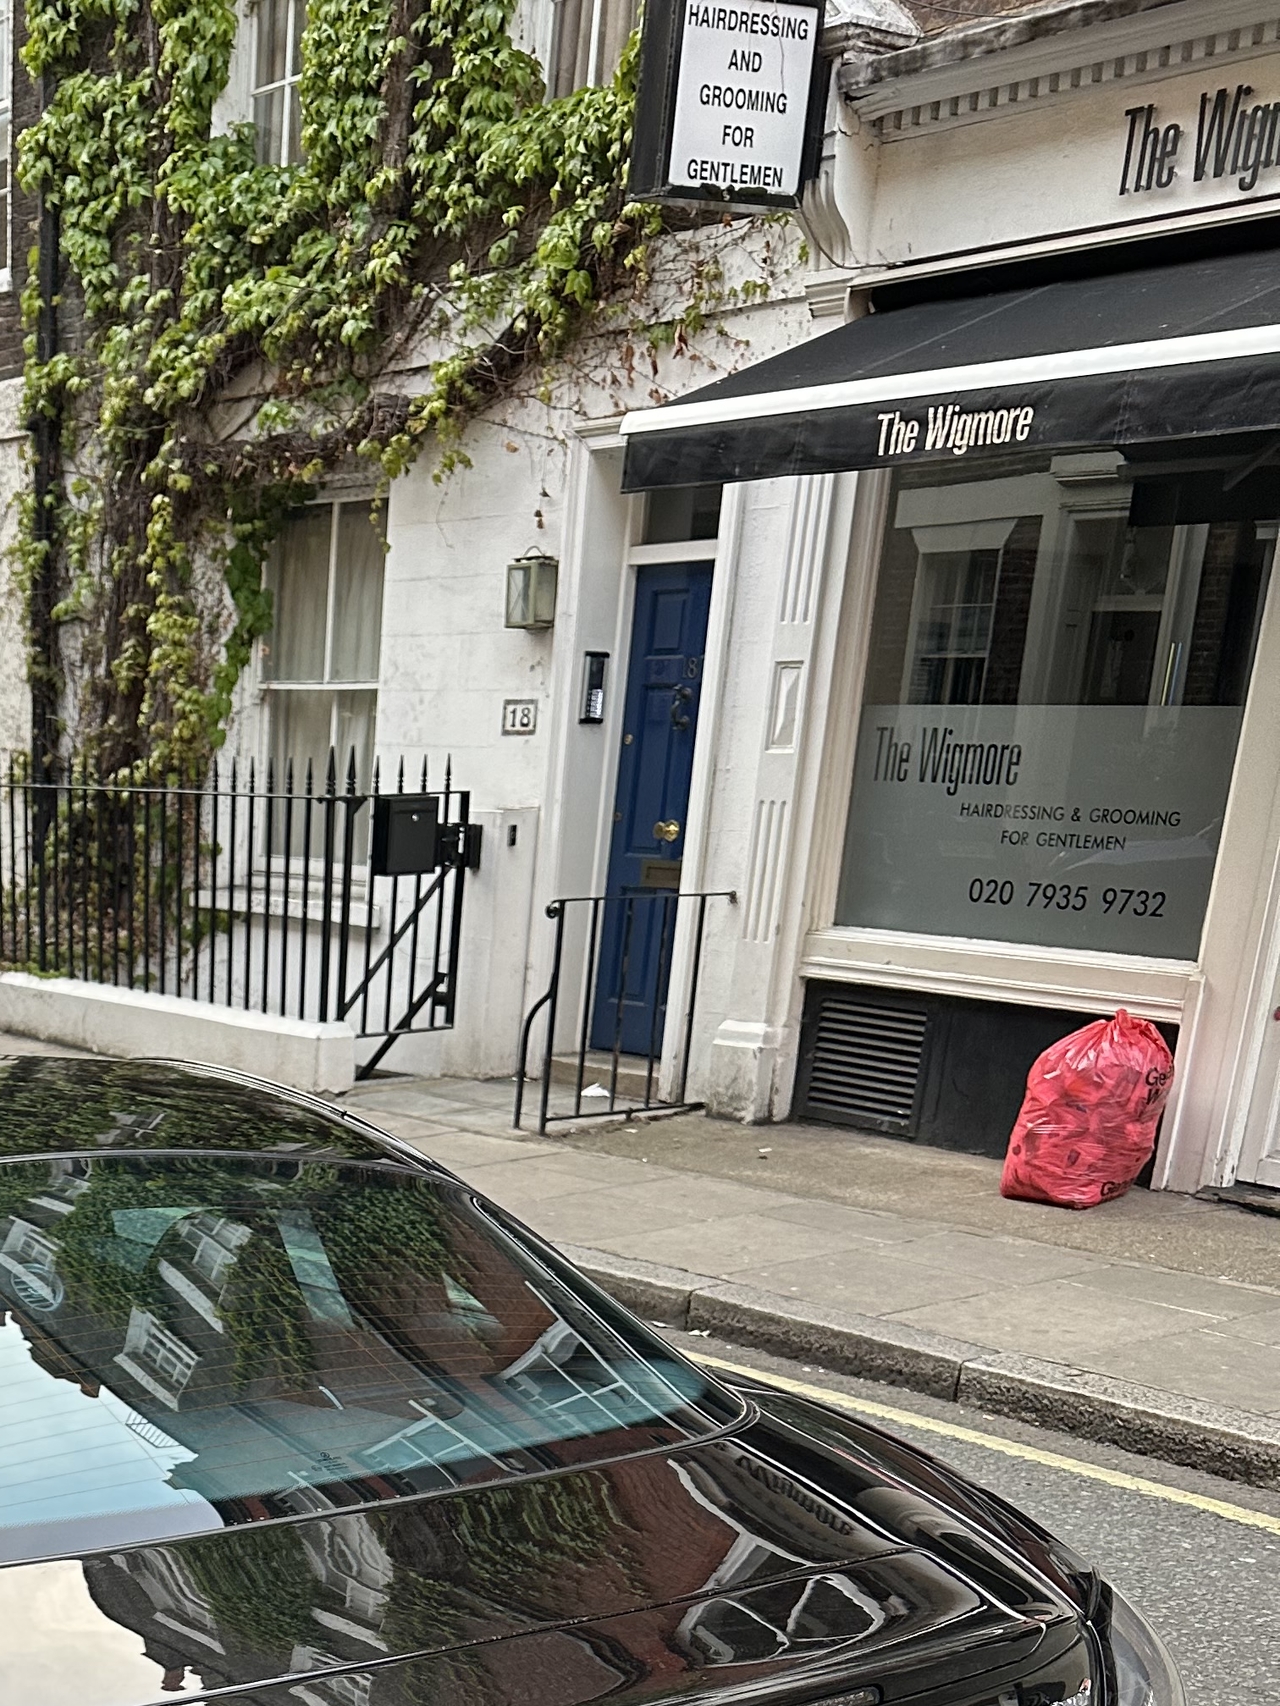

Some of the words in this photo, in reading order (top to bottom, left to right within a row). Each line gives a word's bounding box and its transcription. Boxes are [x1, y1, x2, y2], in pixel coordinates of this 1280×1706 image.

[688, 4, 809, 40] HAIRDRESSING
[728, 49, 763, 73] AND
[700, 84, 788, 114] GROOMING
[722, 125, 755, 148] FOR
[1119, 103, 1181, 196] The
[687, 158, 783, 188] GENTLEMEN
[877, 411, 920, 456] The
[924, 404, 1034, 456] Wigmore
[509, 707, 532, 728] 18
[873, 726, 912, 782] The
[918, 727, 1023, 796] Wigmore
[959, 802, 1065, 822] HAIRDRESSING
[1071, 807, 1082, 822] &
[1089, 808, 1181, 827] GROOMING
[1000, 830, 1029, 846] FOR
[1035, 832, 1127, 851] GENTLEMEN
[969, 878, 1014, 906] 020
[1026, 882, 1088, 912] 7935
[1102, 888, 1167, 917] 9732
